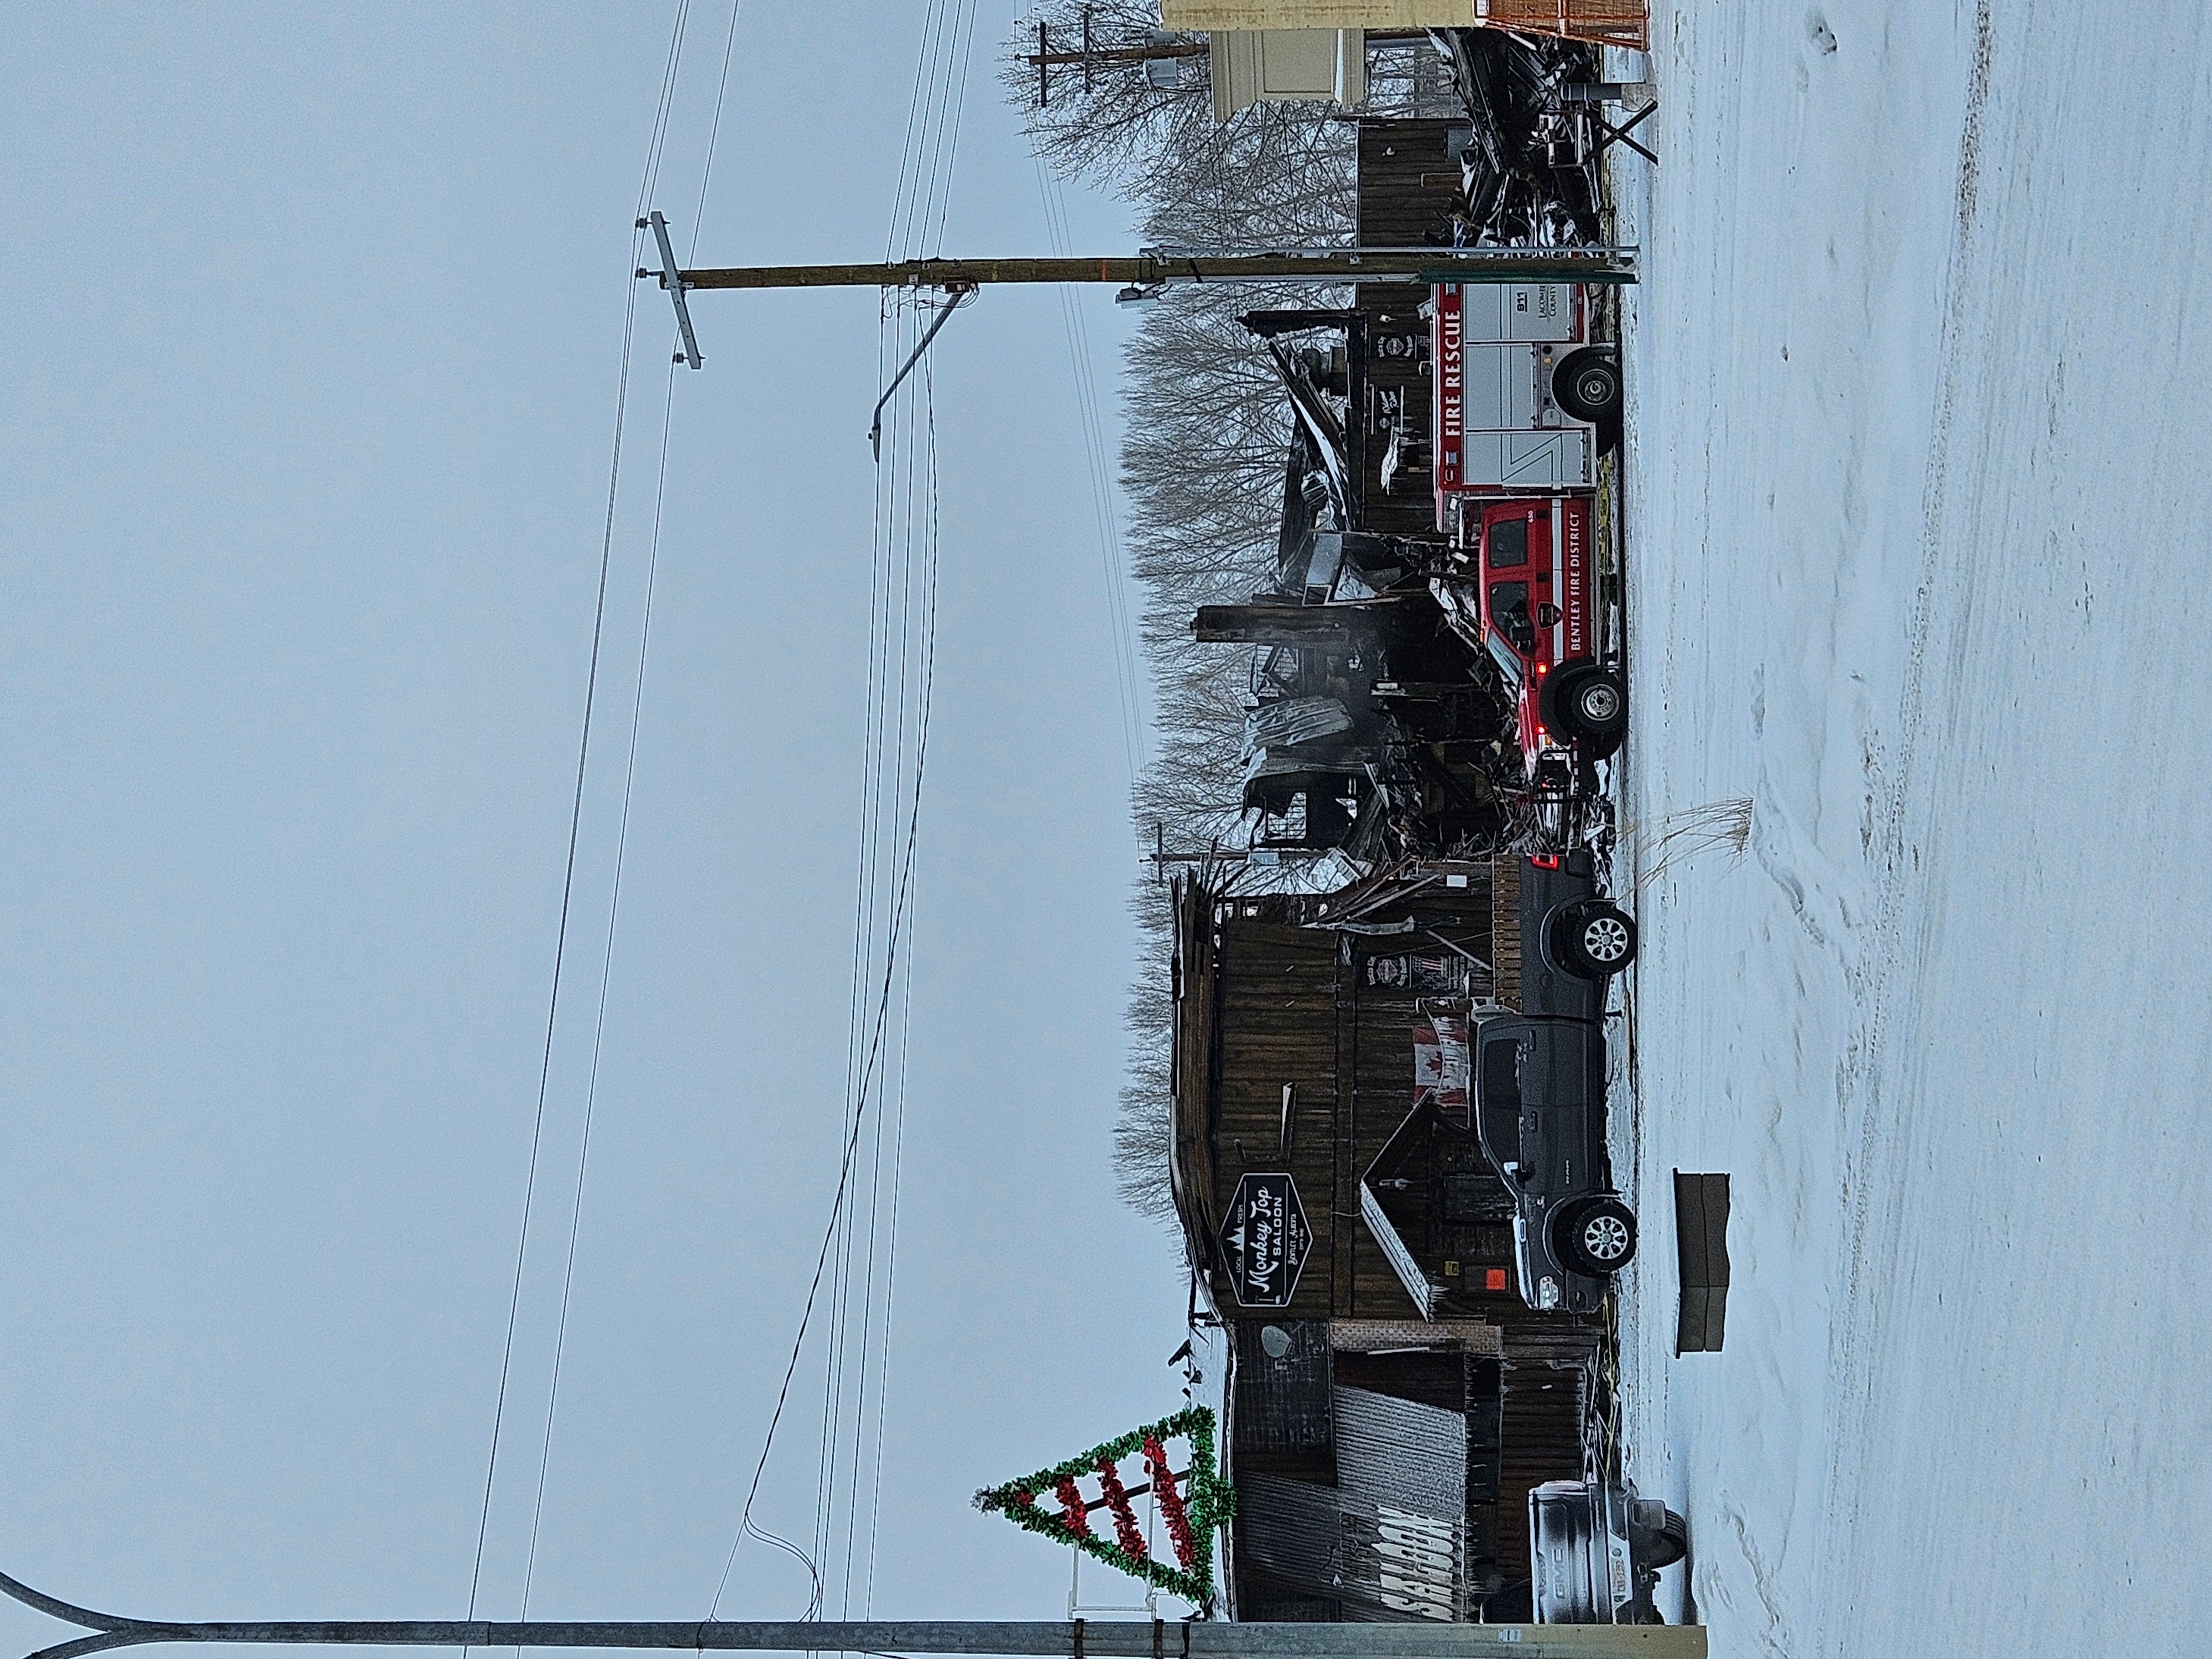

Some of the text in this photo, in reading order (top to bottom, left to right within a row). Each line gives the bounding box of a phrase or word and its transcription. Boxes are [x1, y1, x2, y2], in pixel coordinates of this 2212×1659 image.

[1445, 310, 1460, 436] FIRE RESCUE
[1569, 512, 1580, 650] BENTLEY FIRE DISTRICT
[1248, 1186, 1279, 1292] Monkey Top
[1273, 1197, 1282, 1256] SALOON
[1371, 1504, 1453, 1621] SALOON
